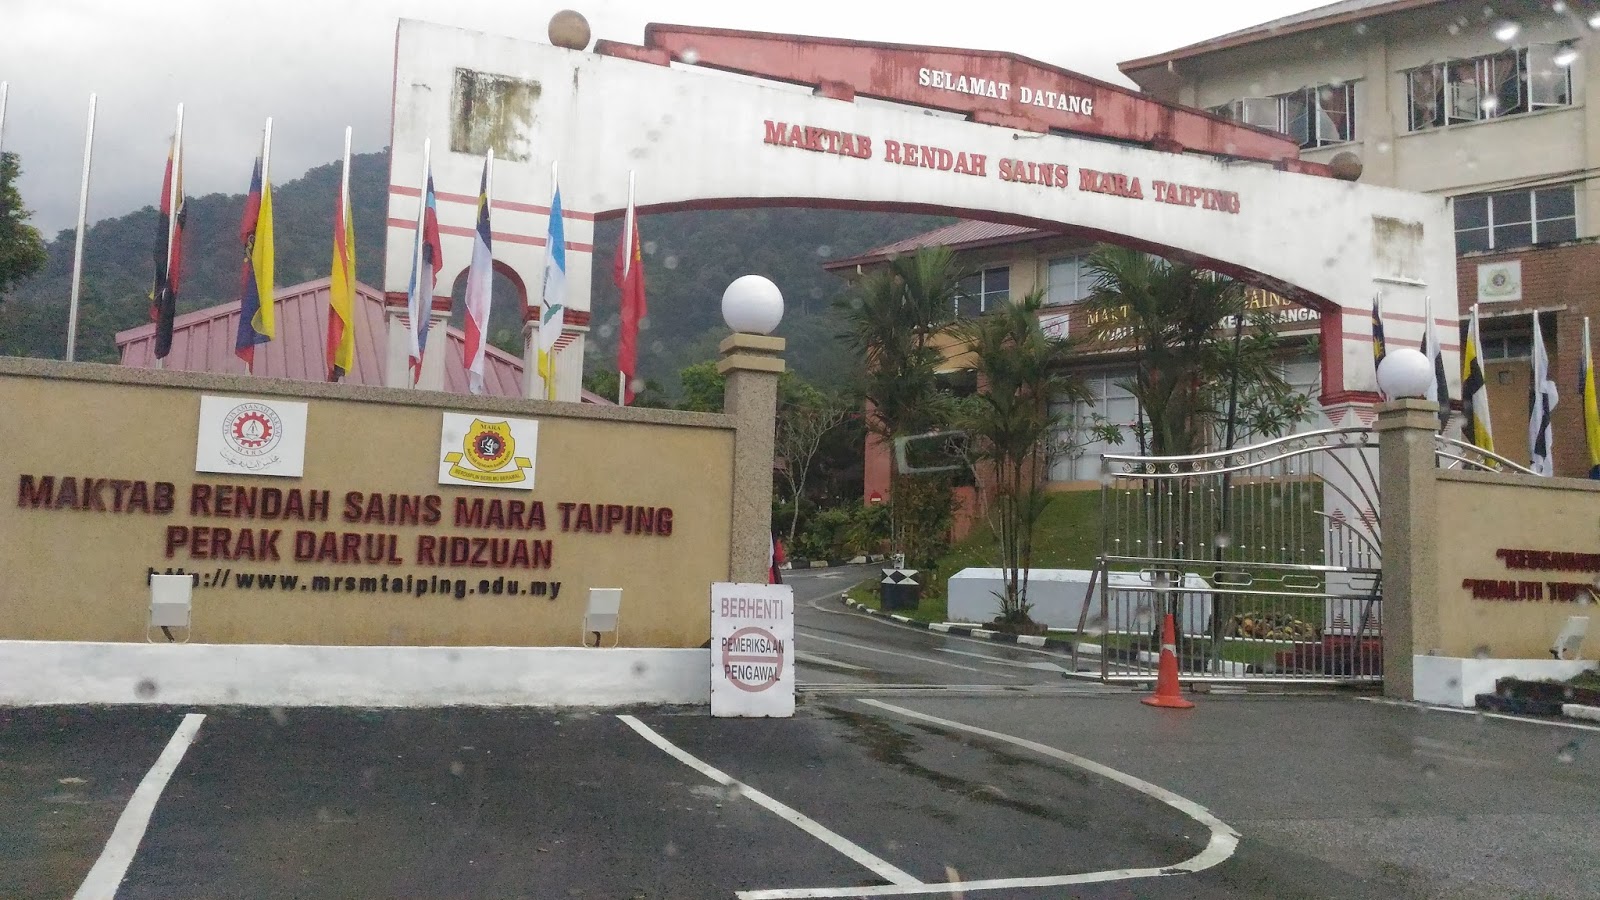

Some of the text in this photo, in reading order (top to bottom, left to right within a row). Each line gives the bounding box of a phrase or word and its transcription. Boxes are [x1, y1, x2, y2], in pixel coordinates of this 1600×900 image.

[918, 67, 1094, 117] SELAMAT DATANG
[763, 119, 1241, 214] MAKTAB RENDAH SAINS MARA TAIPING
[480, 423, 501, 431] MARA
[237, 446, 264, 455] MARA
[17, 473, 675, 537] MAKTAB RENDAH SAINS MARA TAIPING
[164, 524, 554, 570] PERAK DARUL RIDZUAN
[721, 597, 784, 620] BERHENTI
[722, 636, 785, 654] PEMERIKSAAN
[724, 664, 781, 681] PENGAWAL
